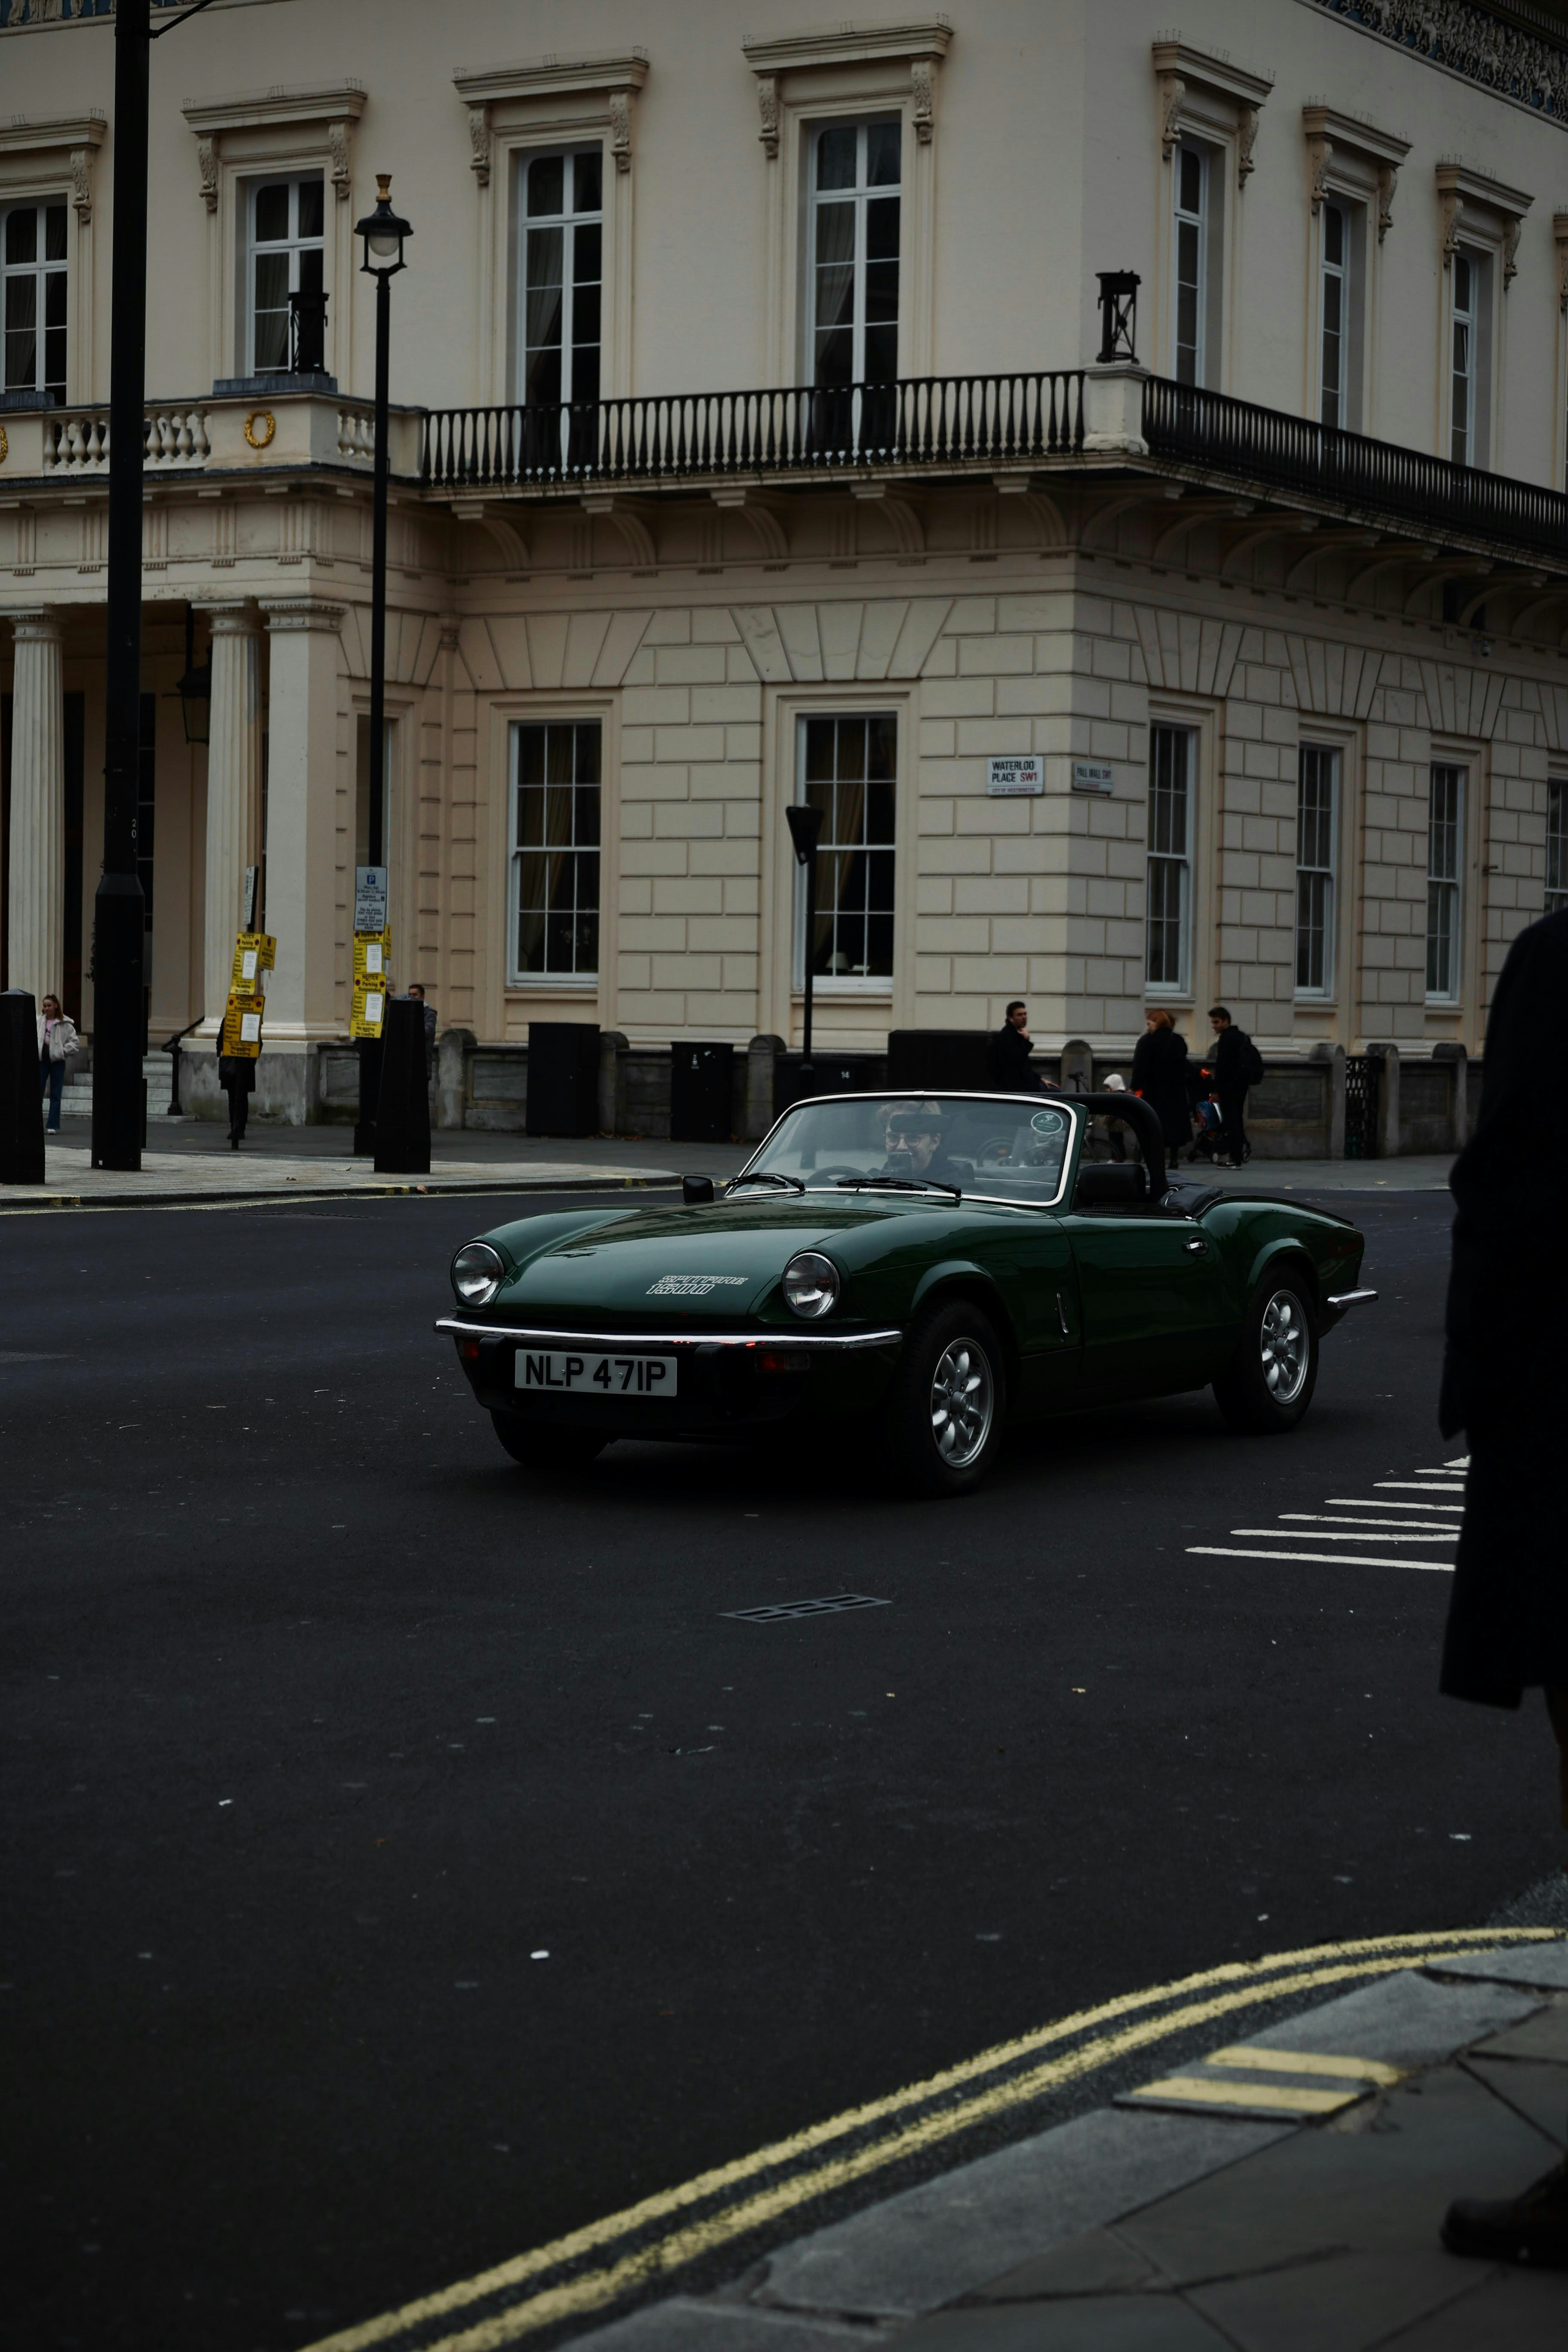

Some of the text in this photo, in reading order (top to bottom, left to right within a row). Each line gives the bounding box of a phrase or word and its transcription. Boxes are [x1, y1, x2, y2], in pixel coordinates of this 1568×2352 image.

[992, 761, 1034, 771] WATERLOO
[992, 772, 1037, 782] PLACE SW1
[1077, 767, 1087, 778] PALL
[1089, 768, 1101, 779] MALL
[658, 1275, 749, 1285] SPITFIRE
[645, 1283, 715, 1295] 1500
[525, 1354, 666, 1392] NLP 471P
